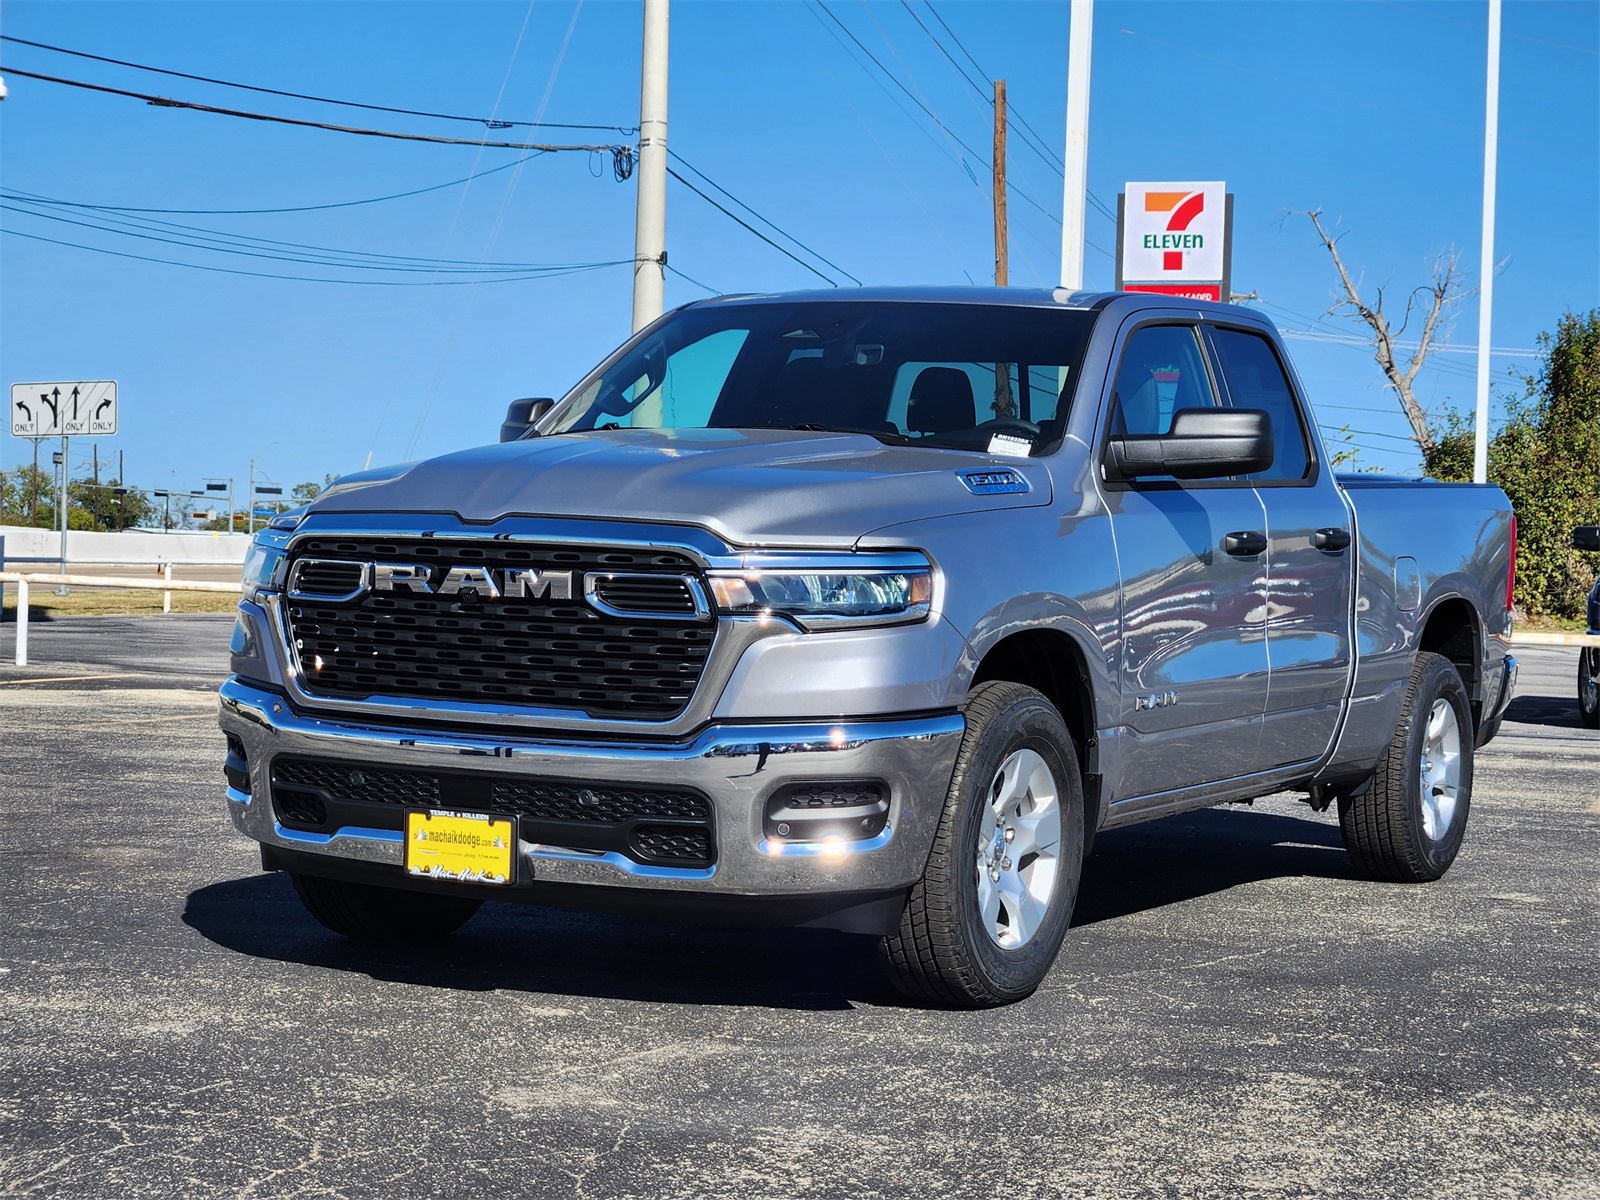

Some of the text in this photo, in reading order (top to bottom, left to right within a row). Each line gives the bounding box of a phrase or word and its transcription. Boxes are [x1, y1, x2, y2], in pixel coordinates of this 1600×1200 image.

[14, 423, 34, 432] ONLY
[65, 422, 85, 431] ONLY
[92, 421, 113, 430] ONLY
[968, 473, 1021, 486] 1500
[374, 561, 574, 600] RAM
[1135, 690, 1180, 711] RAM
[429, 809, 490, 820] TEMPLE KILLEEN
[429, 830, 492, 848] machaikdodge.com
[430, 864, 454, 879] Mac
